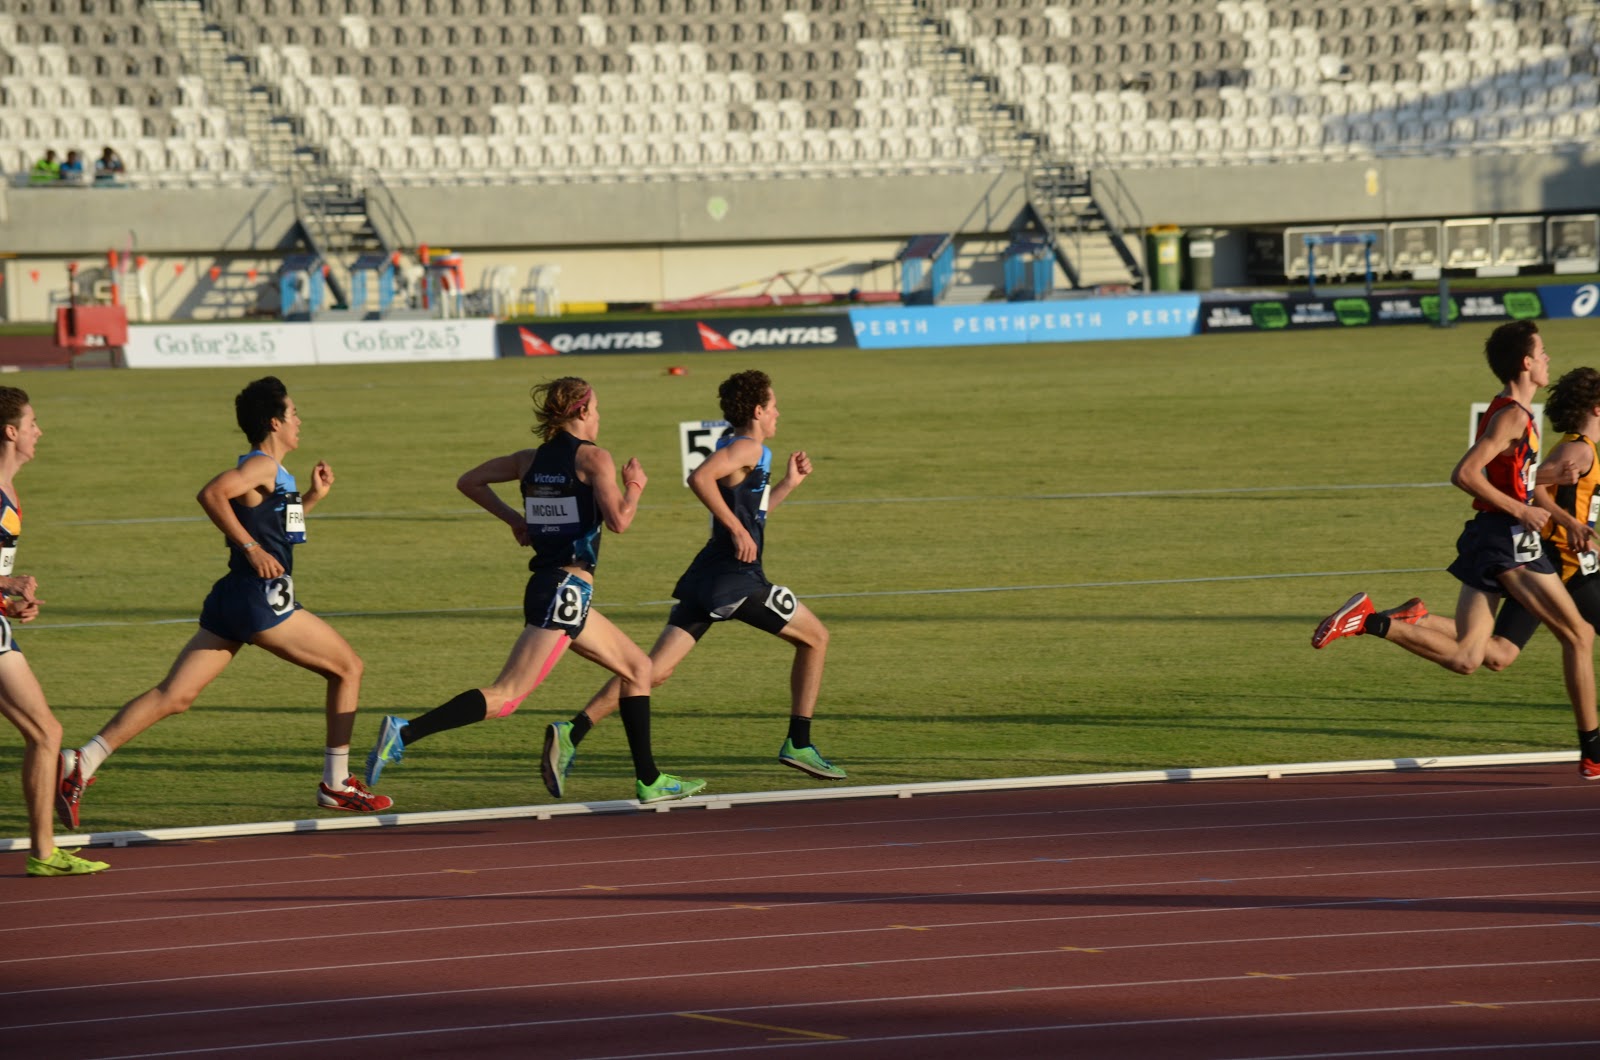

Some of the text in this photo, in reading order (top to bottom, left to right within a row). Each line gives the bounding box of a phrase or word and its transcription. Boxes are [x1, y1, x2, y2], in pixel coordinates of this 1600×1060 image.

[854, 315, 1026, 336] PERTH PERTH
[1029, 312, 1102, 329] PERTH
[154, 333, 188, 353] Go
[192, 332, 223, 353] for
[343, 330, 375, 351] Go
[378, 329, 410, 350] for
[551, 331, 663, 352] QANTAS
[728, 326, 838, 348] QANTAS
[534, 472, 566, 483] Victoria
[532, 504, 568, 517] MCGILL
[1517, 530, 1539, 558] 4
[270, 577, 290, 612] 3
[558, 587, 578, 622] 8
[772, 588, 796, 615] 6
